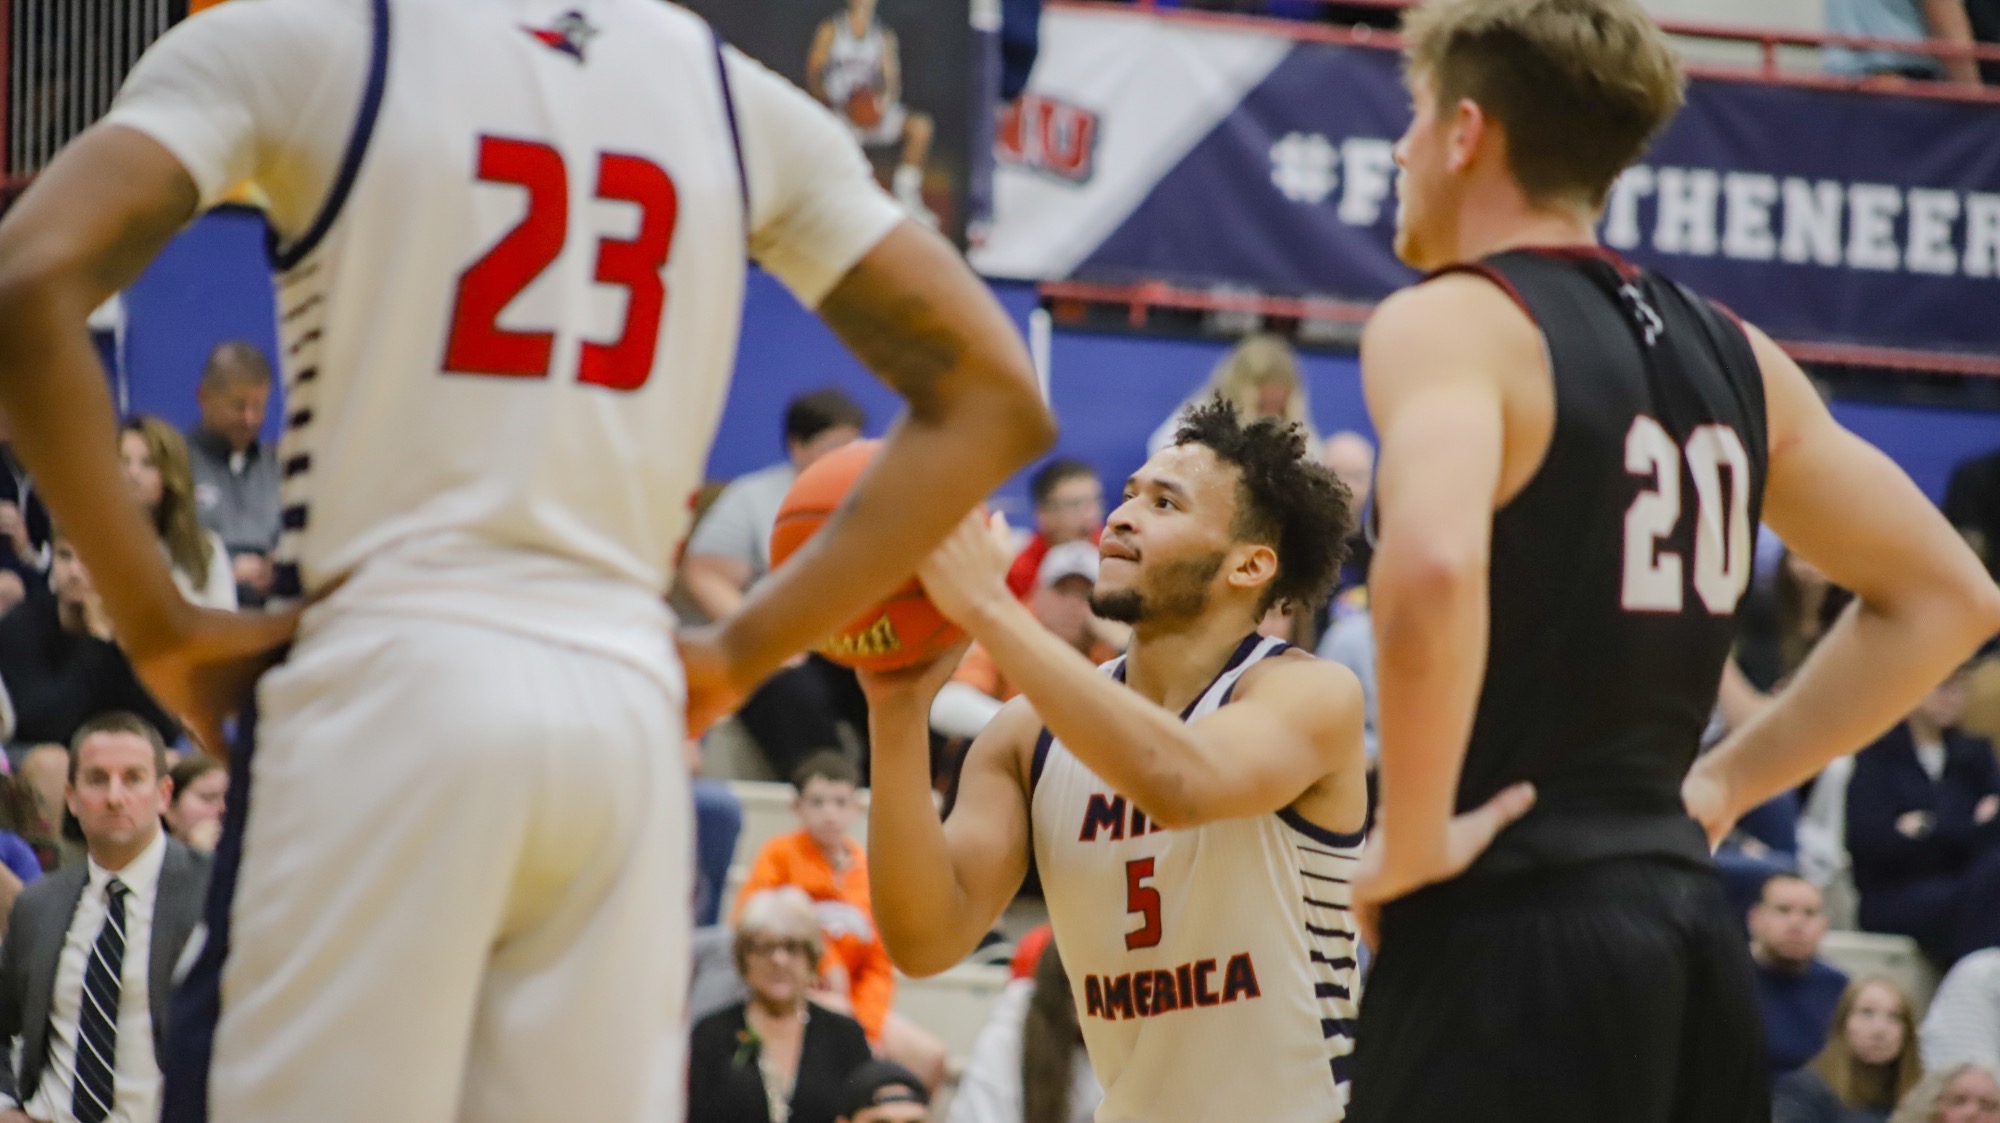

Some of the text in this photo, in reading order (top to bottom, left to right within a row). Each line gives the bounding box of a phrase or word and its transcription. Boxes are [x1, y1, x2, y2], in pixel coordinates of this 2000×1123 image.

[440, 134, 677, 391] 23
[1621, 413, 1751, 615] 20
[1079, 793, 1168, 842] MI
[1124, 857, 1162, 951] 5
[1085, 952, 1261, 1021] AMERICA
